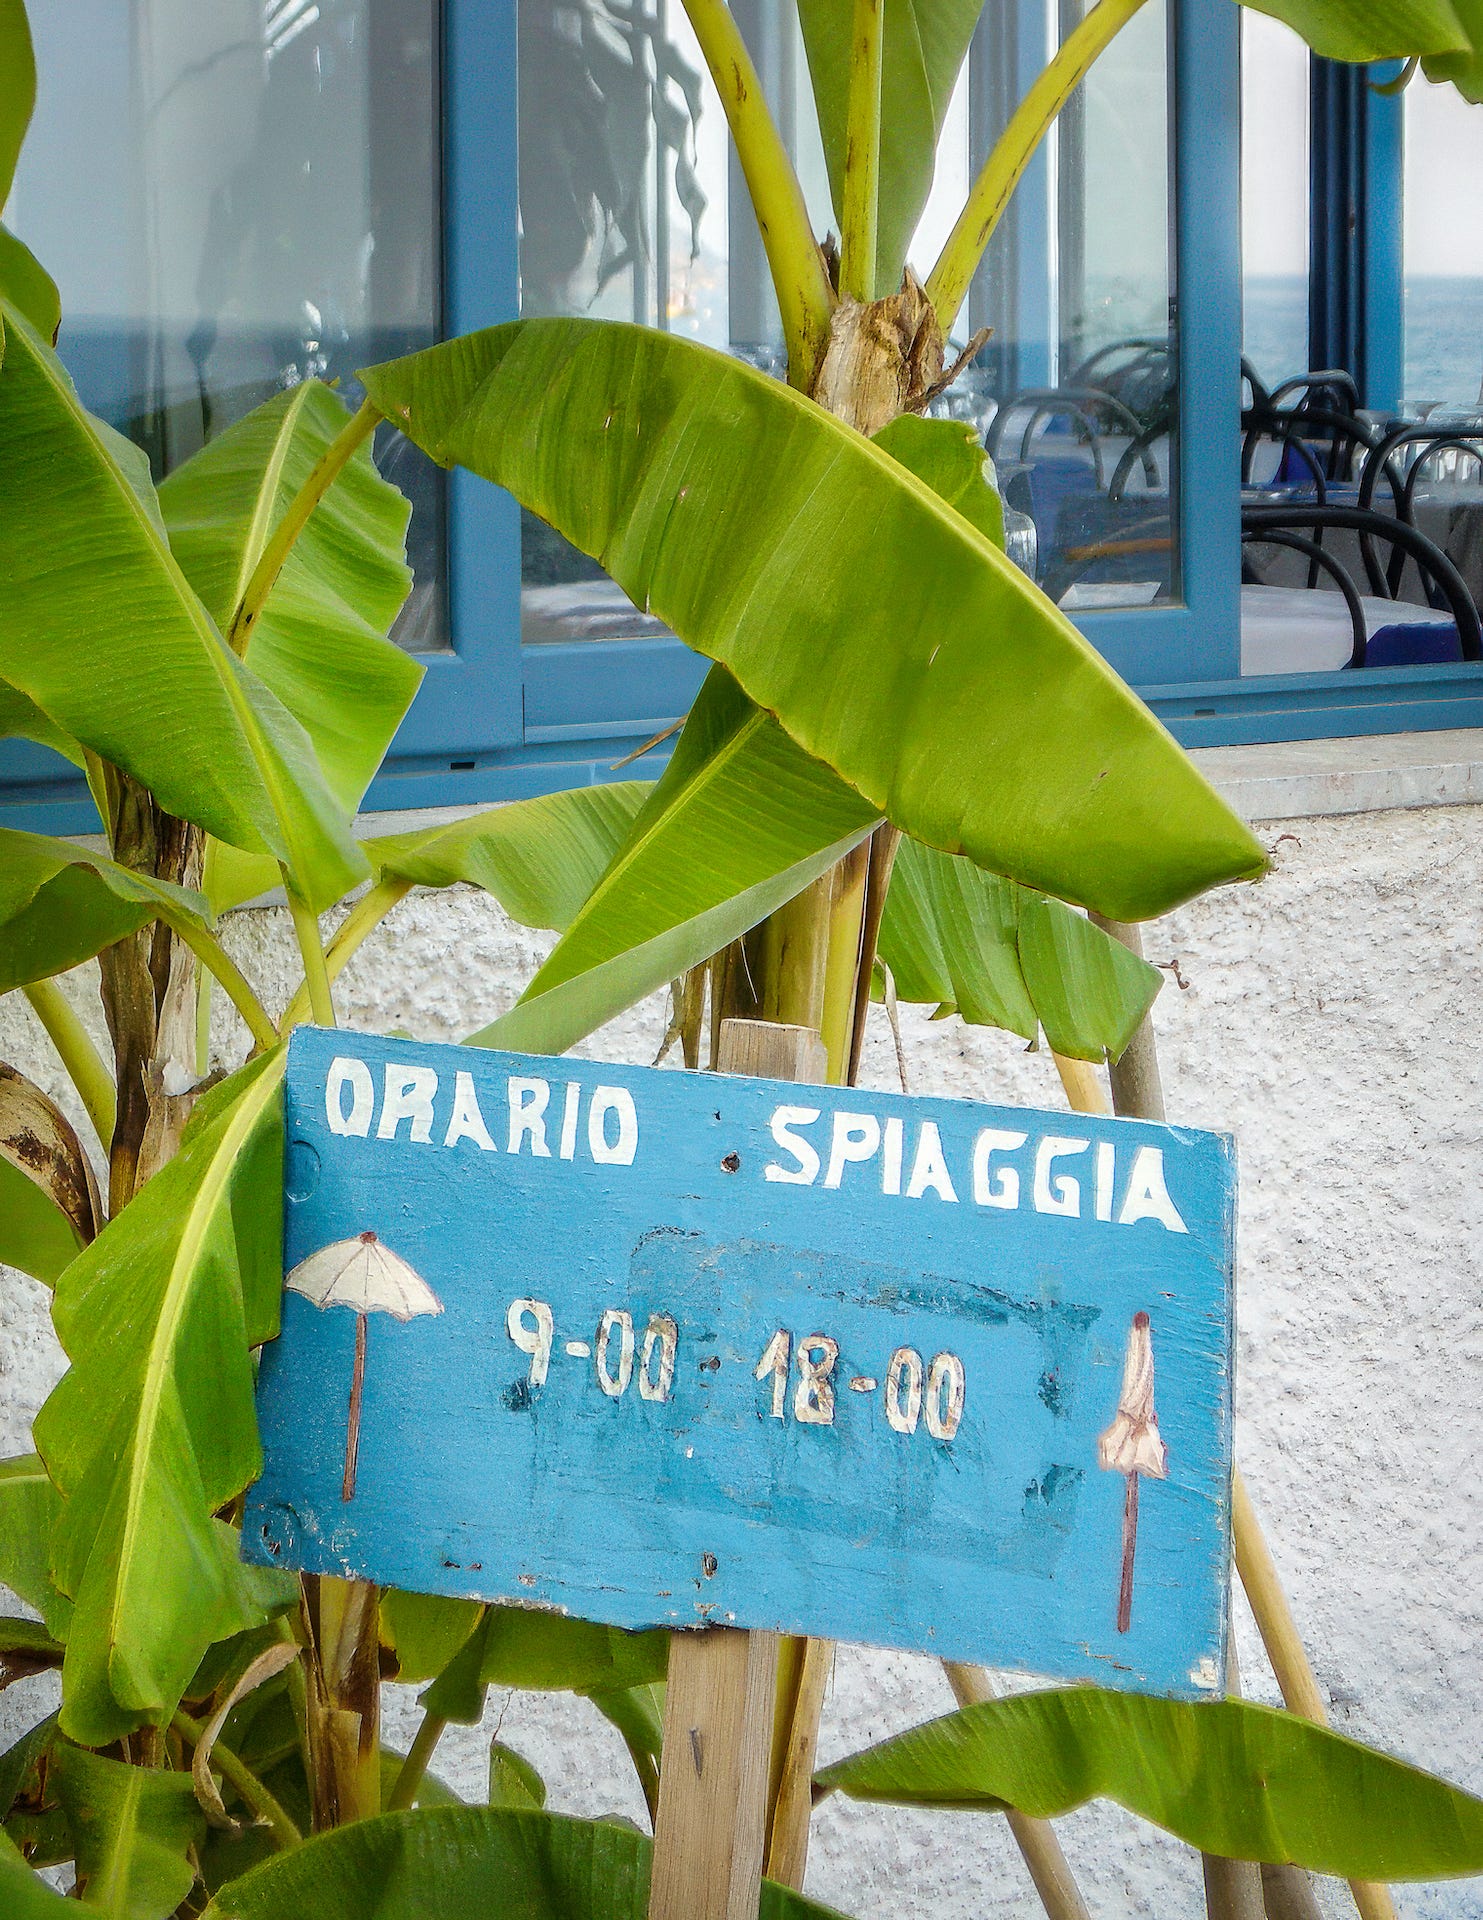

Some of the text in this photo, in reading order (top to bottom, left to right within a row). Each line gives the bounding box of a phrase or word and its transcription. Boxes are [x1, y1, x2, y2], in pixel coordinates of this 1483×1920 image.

[325, 1056, 1190, 1234] ORARIO SPIAGGIA
[505, 1298, 966, 1441] 9-00 18-00
